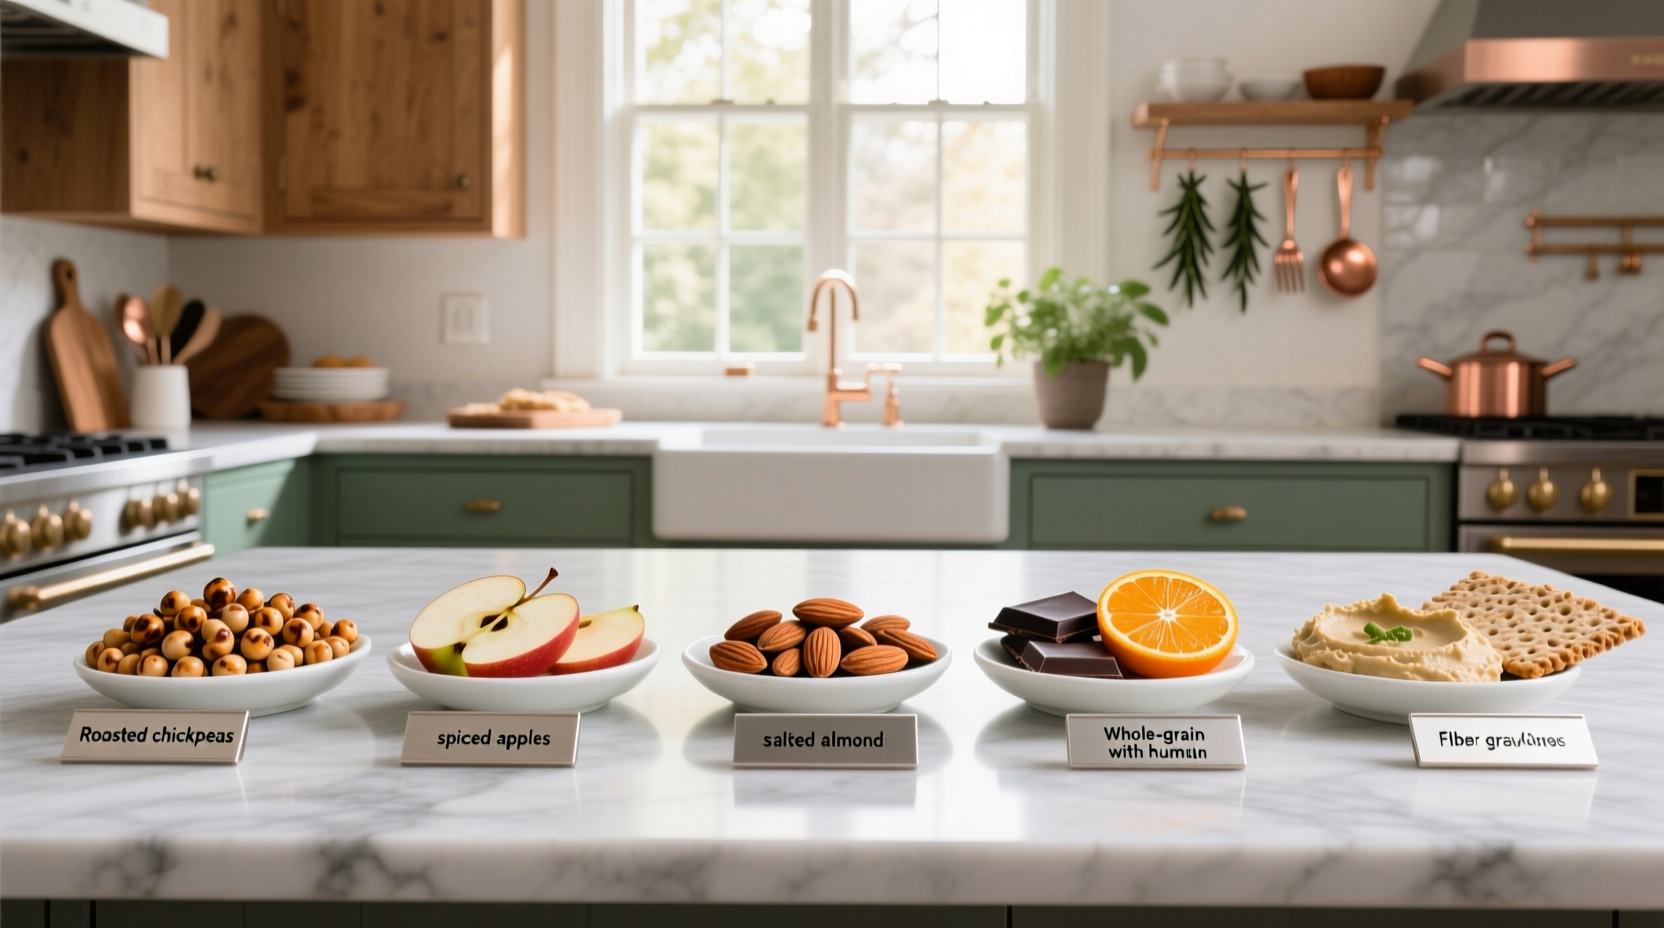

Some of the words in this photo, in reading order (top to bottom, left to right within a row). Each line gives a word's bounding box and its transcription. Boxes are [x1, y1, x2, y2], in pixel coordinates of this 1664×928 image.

[79, 726, 148, 743] Roasted
[152, 726, 234, 747] chickpeas
[437, 729, 491, 749] spiced
[497, 729, 551, 750] apples
[763, 731, 815, 747] salted
[821, 731, 884, 747] almond
[1104, 726, 1205, 744] Whole-grain
[1109, 744, 1144, 759] with
